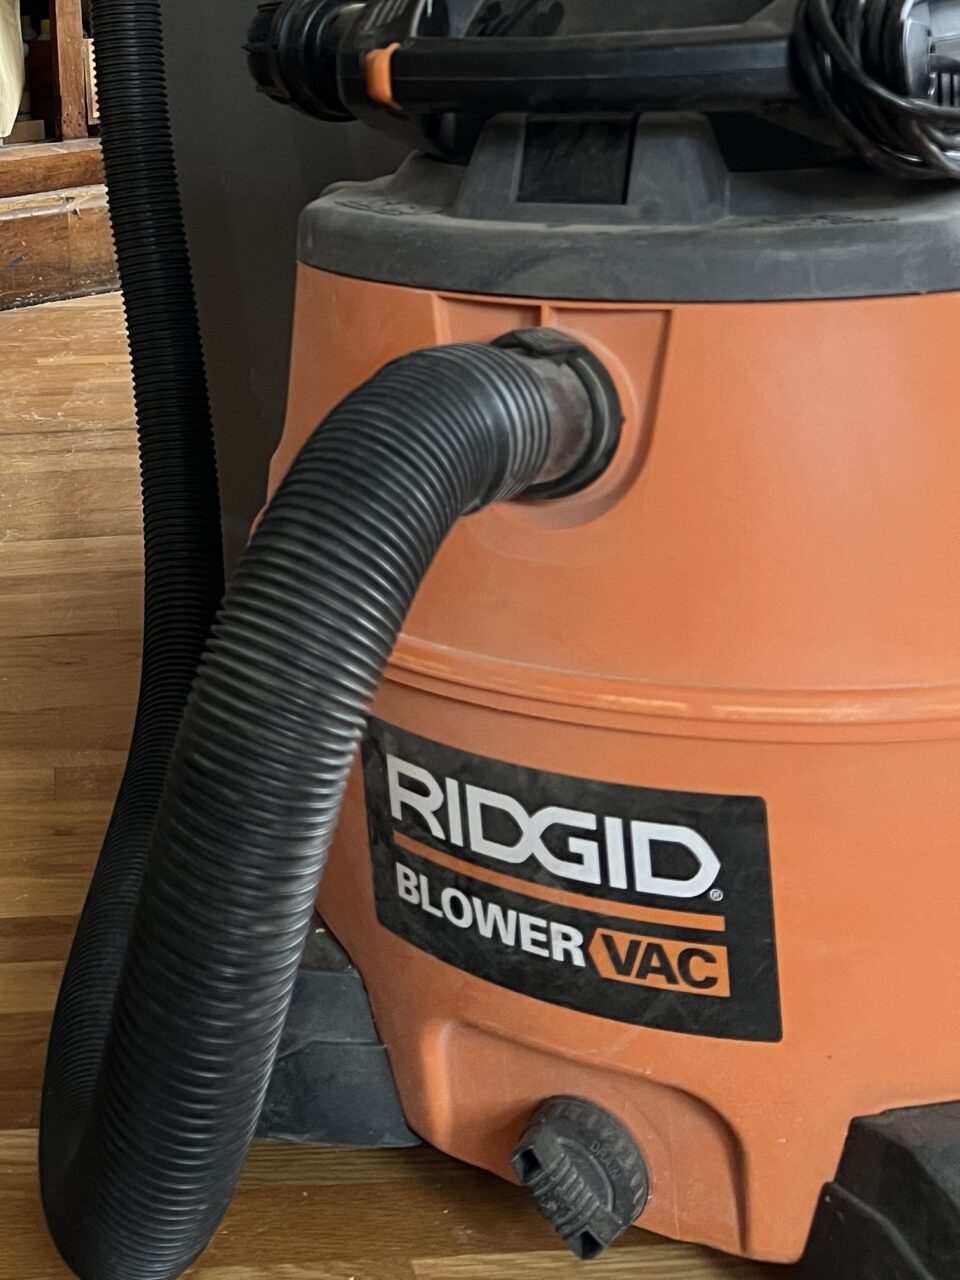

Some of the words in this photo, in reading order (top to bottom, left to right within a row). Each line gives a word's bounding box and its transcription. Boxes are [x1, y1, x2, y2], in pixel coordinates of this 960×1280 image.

[387, 754, 721, 898] RIDGID
[396, 862, 586, 967] BLOWER
[601, 934, 718, 990] VAC
